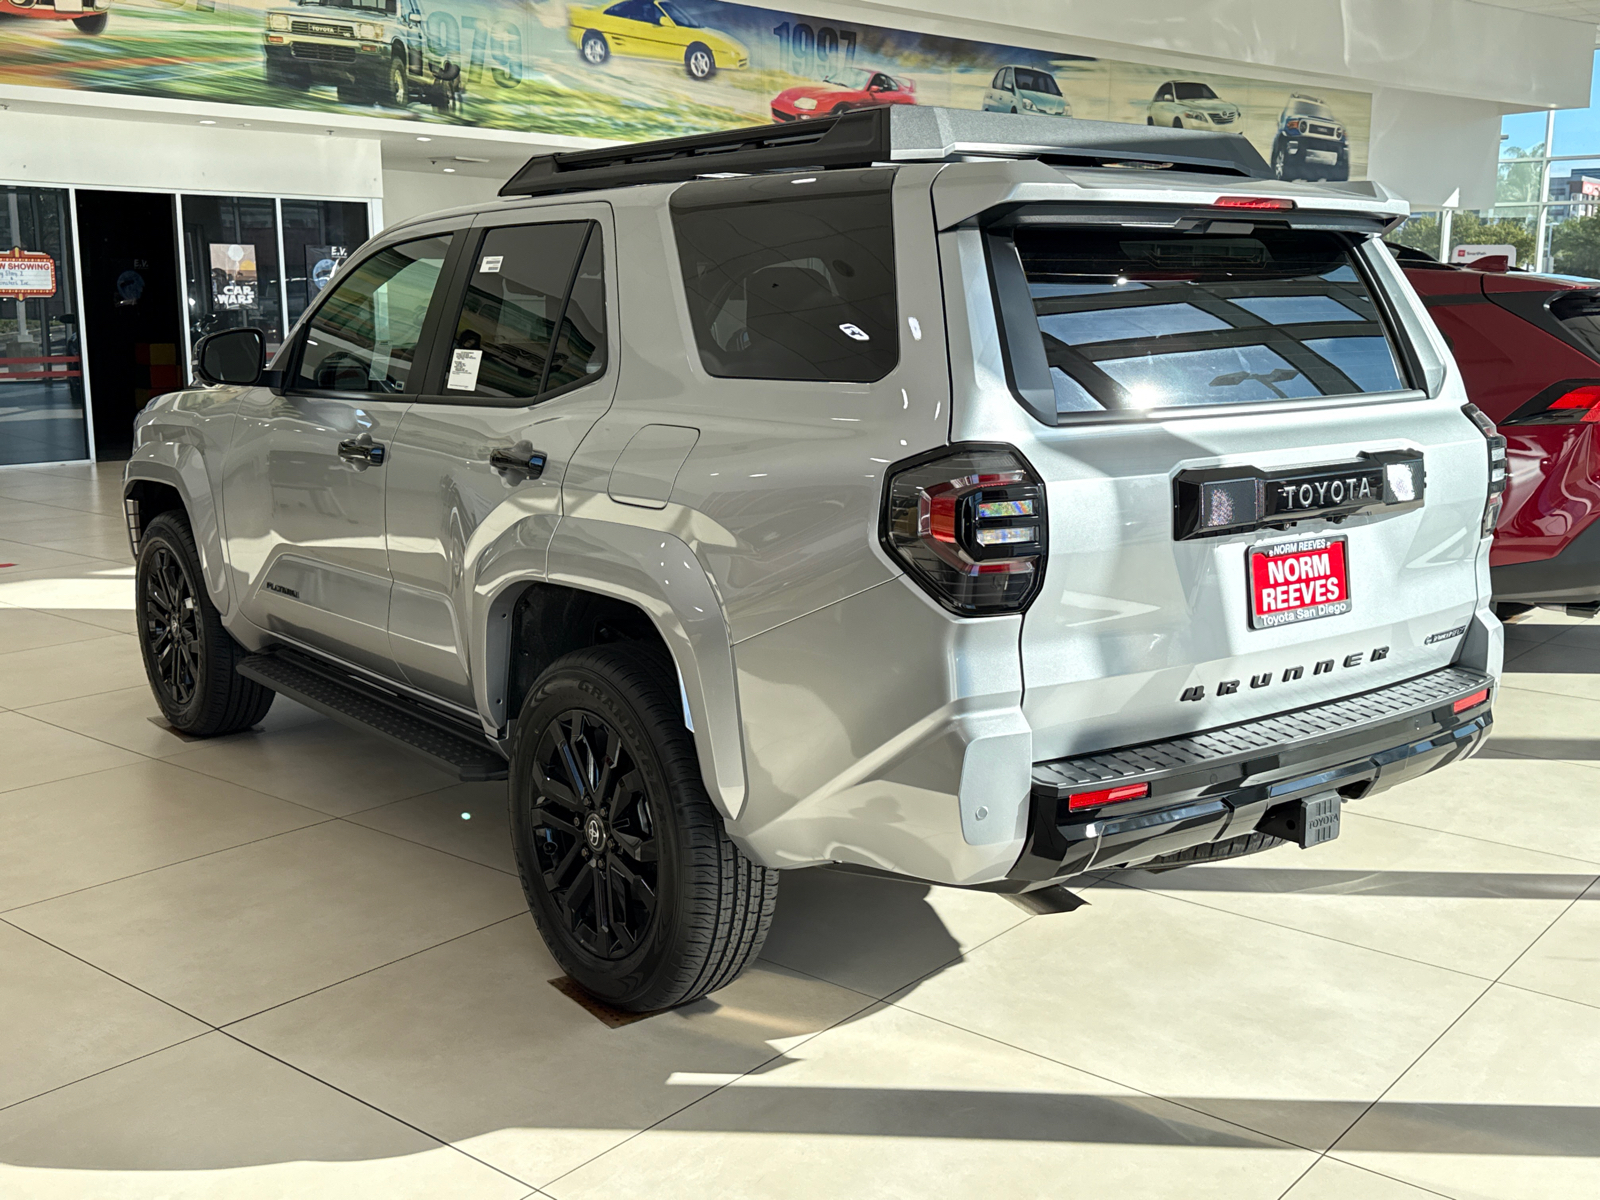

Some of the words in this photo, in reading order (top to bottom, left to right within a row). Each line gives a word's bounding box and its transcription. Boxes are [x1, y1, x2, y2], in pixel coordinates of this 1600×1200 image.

[773, 21, 857, 79] 1997
[331, 246, 348, 256] E.V.
[217, 295, 255, 304] WARS
[223, 286, 255, 295] CAR
[1283, 477, 1371, 509] TOYOTA
[1273, 543, 1298, 555] NORM
[1298, 539, 1326, 552] REEVES
[1267, 553, 1331, 585] NORM
[1262, 577, 1340, 612] REEVES
[1260, 614, 1295, 626] Toyota
[1297, 608, 1316, 619] San
[1318, 603, 1347, 616] Diego
[1180, 646, 1390, 702] 4RUNNER
[1309, 813, 1339, 830] TOYOTA
